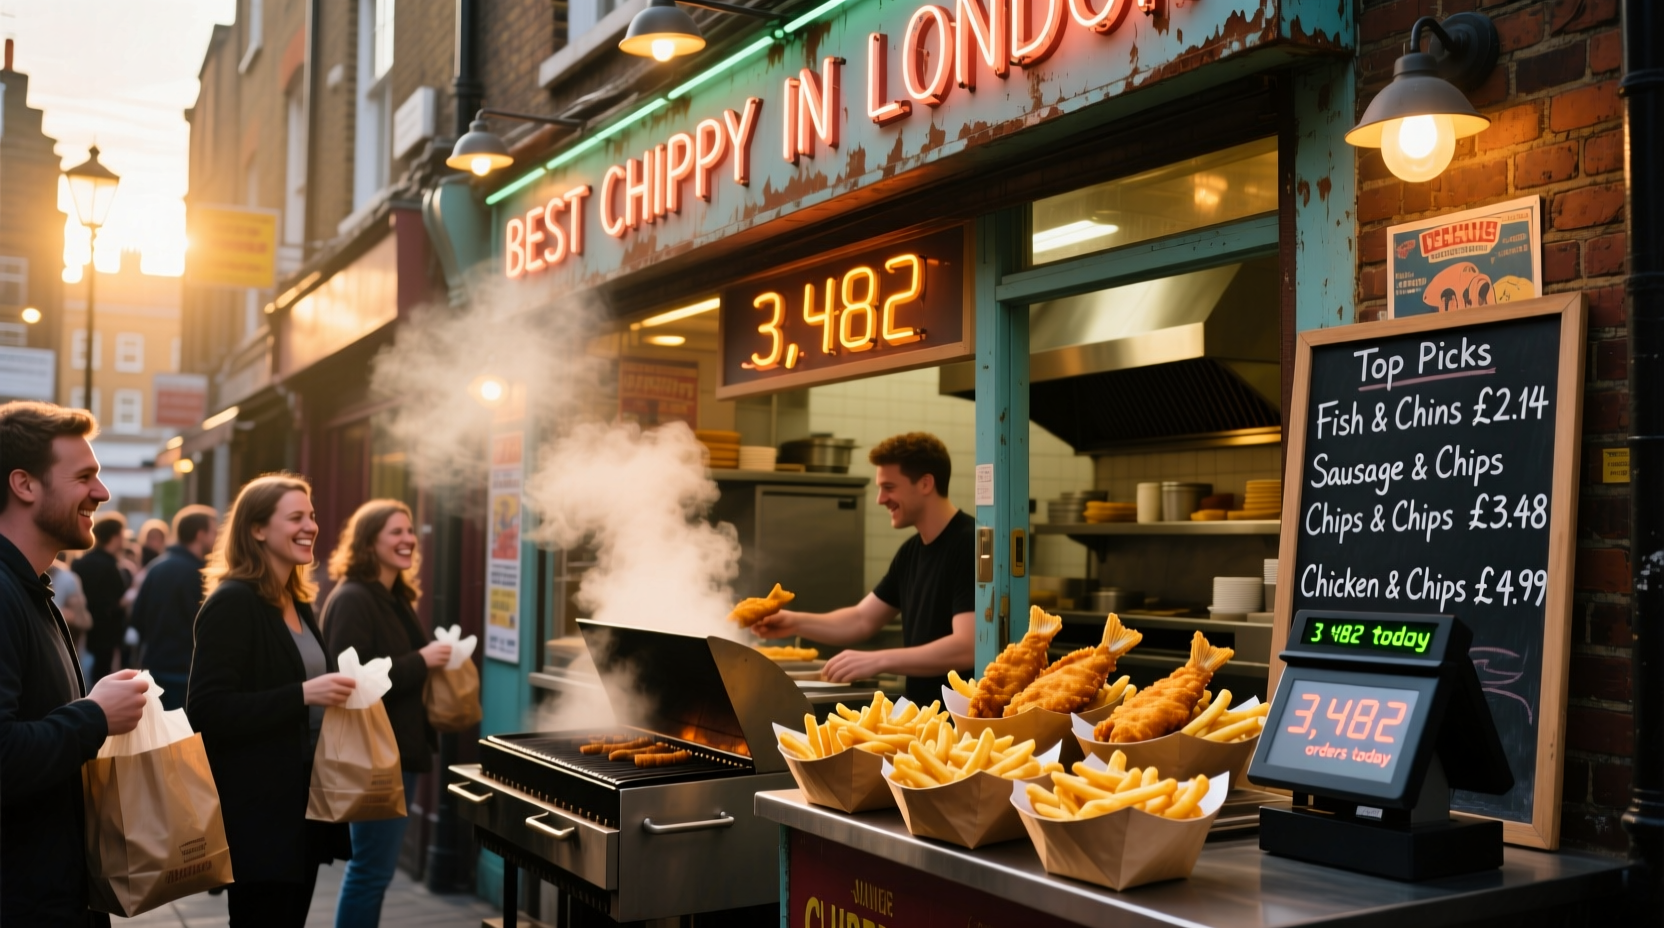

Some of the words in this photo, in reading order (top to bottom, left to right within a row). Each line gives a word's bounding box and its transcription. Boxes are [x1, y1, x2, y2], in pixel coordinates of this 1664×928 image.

[505, 184, 592, 279] BEST
[600, 97, 763, 238] CHIPPY
[783, 55, 844, 164] IN
[751, 254, 924, 371] 3,482
[1353, 347, 1404, 391] Top
[1418, 337, 1492, 374] Picks
[1317, 400, 1363, 439] Fish
[1371, 402, 1388, 432] &
[1395, 394, 1462, 430] Chins
[1472, 385, 1549, 427] £2.14
[1311, 453, 1404, 496] Sausage
[1411, 452, 1428, 480] &
[1435, 444, 1504, 487] Chips
[1305, 502, 1364, 544] Chips
[1370, 504, 1386, 532] &
[1392, 499, 1453, 543] Chips
[1469, 493, 1548, 530] £3.48
[1301, 564, 1379, 598] Chicken
[1385, 570, 1400, 600] &
[1405, 566, 1466, 613] Chips
[1474, 566, 1548, 607] £4.99
[1372, 625, 1430, 652] today
[1287, 693, 1408, 744] 3,482
[1305, 742, 1348, 761] orders
[1352, 746, 1391, 768] today
